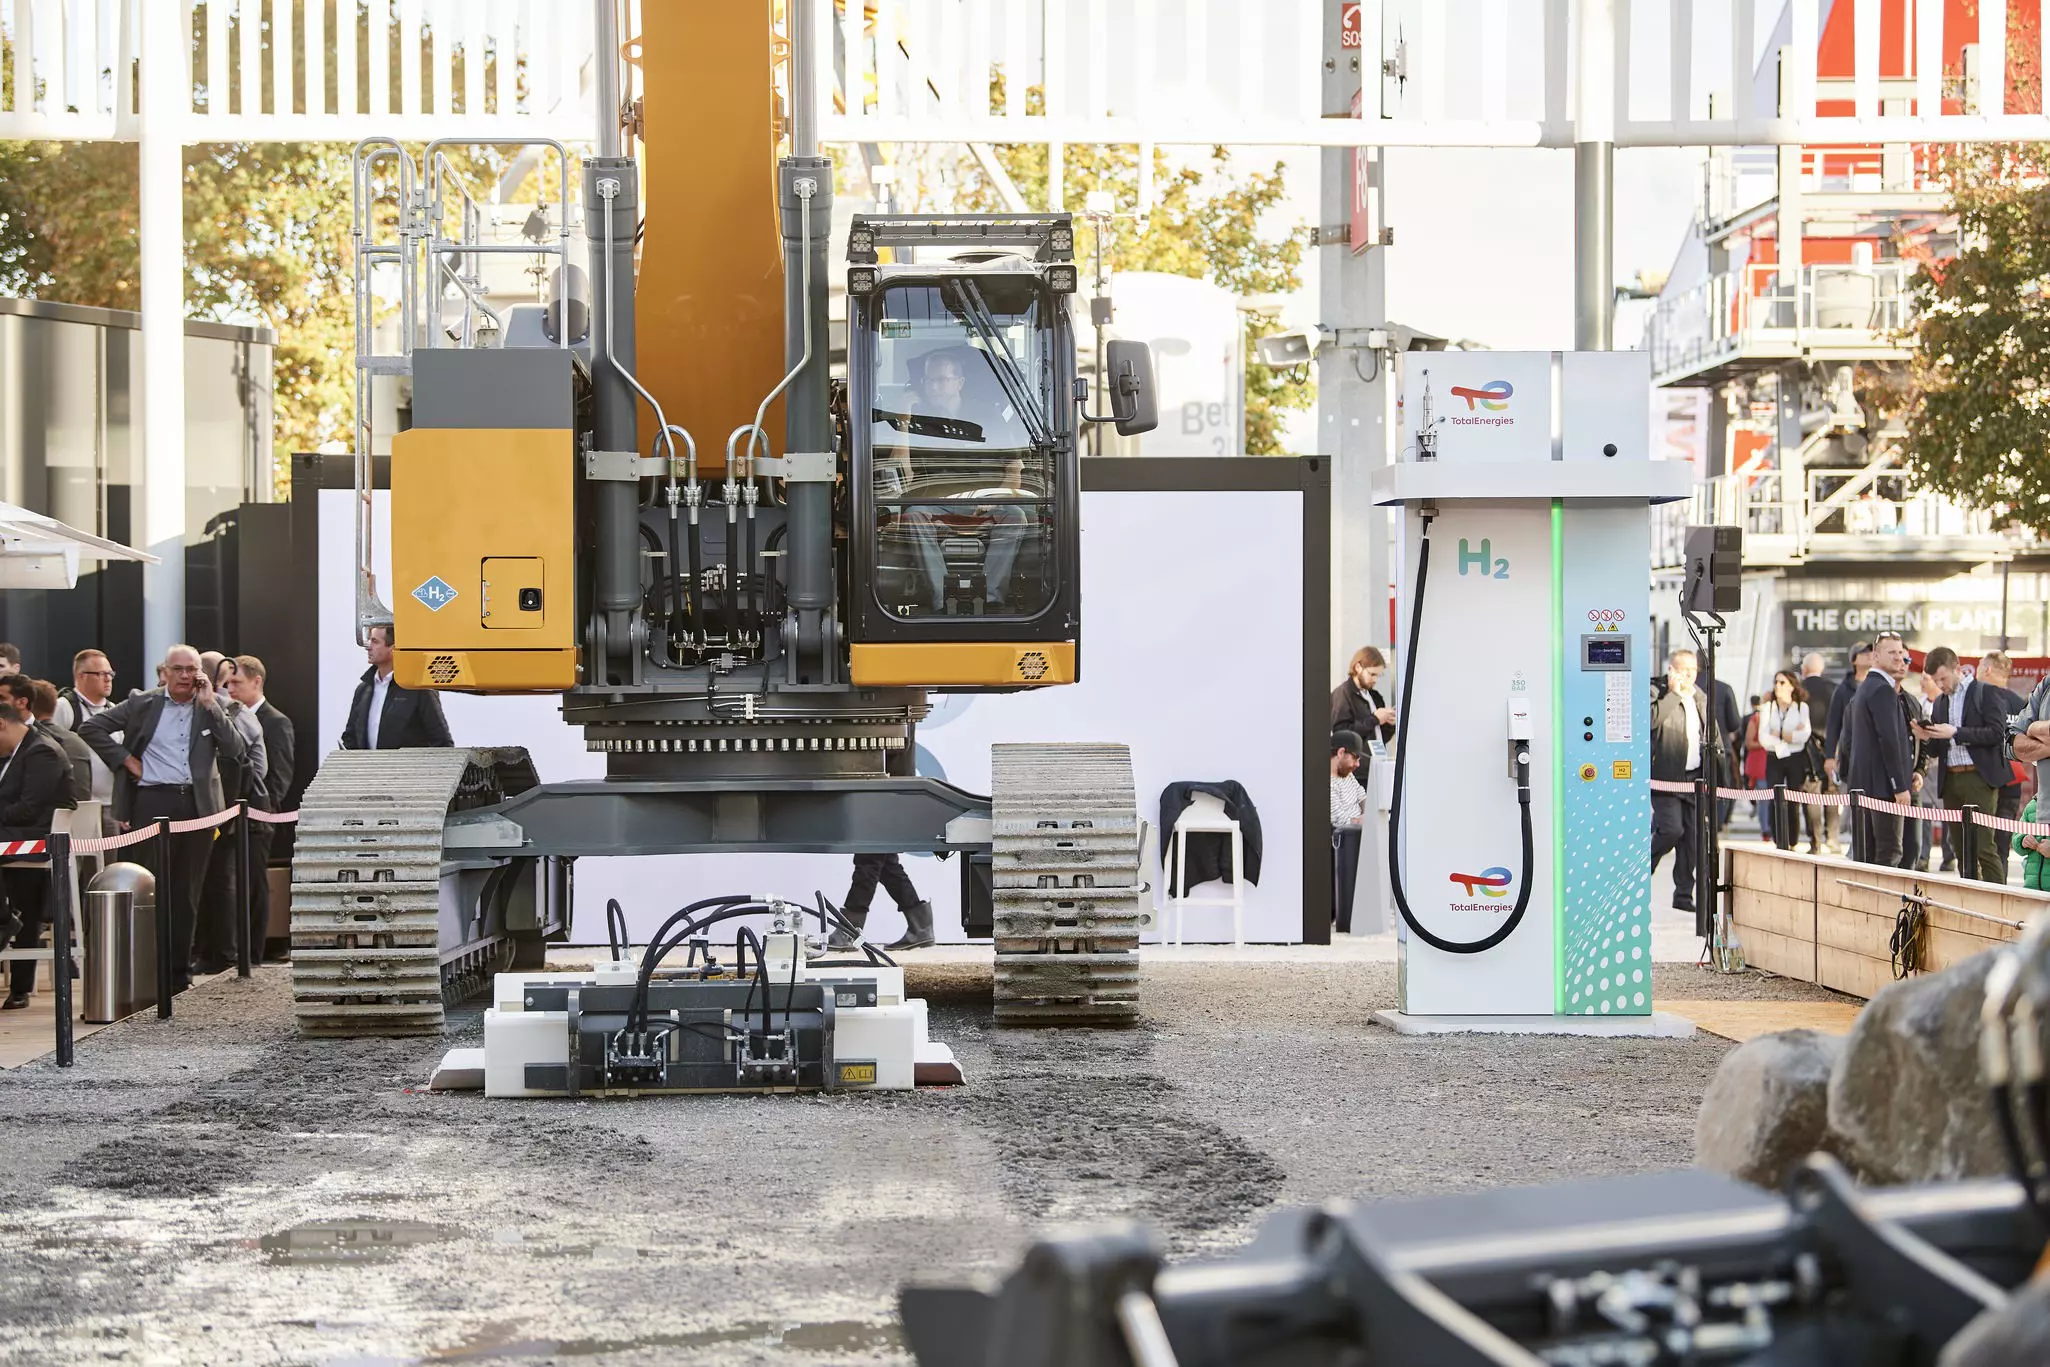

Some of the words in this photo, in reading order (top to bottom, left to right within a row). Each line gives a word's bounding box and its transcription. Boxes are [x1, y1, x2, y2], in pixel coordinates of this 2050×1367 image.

[1450, 416, 1514, 426] TotalEnergies
[1792, 608, 1839, 631] THE
[1844, 608, 1921, 631] GREEN
[1928, 608, 2003, 631] PLANT
[1449, 903, 1513, 913] TotalEnergies
